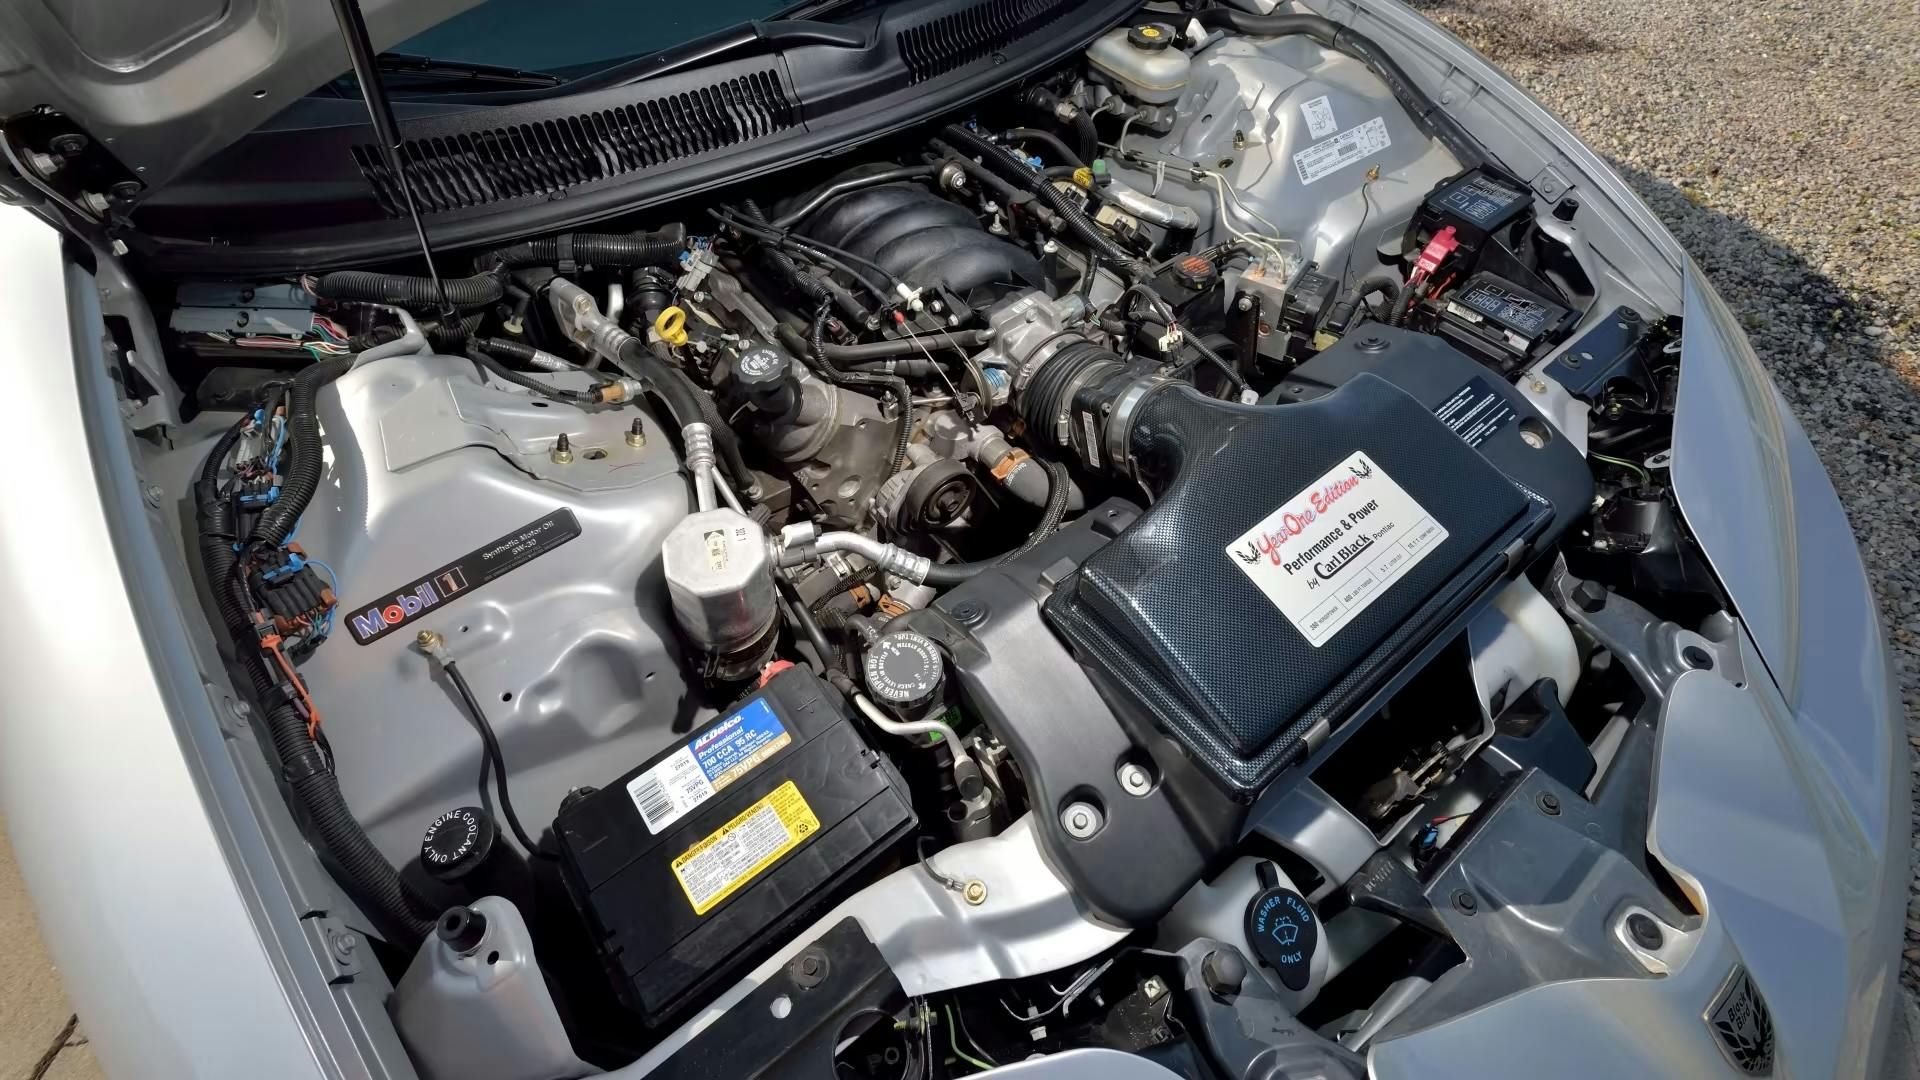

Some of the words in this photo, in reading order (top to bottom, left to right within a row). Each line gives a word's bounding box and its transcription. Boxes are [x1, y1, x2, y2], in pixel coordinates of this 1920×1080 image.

[1256, 509, 1317, 566] YearOne
[1310, 475, 1360, 514] Edition
[1283, 527, 1344, 575] Performance
[1339, 519, 1353, 532] &
[1348, 498, 1379, 525] Power
[482, 539, 520, 560] Synthetic
[520, 527, 542, 542] Motor
[542, 520, 555, 530] Oil
[1306, 576, 1320, 590] by
[1314, 555, 1341, 580] Carl
[1340, 533, 1371, 564] Black
[1372, 520, 1395, 541] Pontiac
[352, 582, 439, 639] Mobil
[870, 670, 884, 689] OPEN
[884, 676, 896, 688] LEVEL
[884, 686, 910, 698] NEVER
[695, 715, 742, 750] ACDelco
[698, 726, 744, 760] Professional
[702, 755, 716, 769] 700
[716, 745, 734, 759] CCA
[735, 738, 745, 748] 95
[745, 729, 757, 740] RC
[731, 754, 760, 778] 75VPG
[425, 810, 461, 842] ENGINE
[452, 812, 477, 860] COOLANT
[424, 846, 447, 863] ONLY
[1258, 896, 1280, 932] WASHER
[1287, 897, 1309, 922] FLUID
[1281, 951, 1303, 964] ONLY
[1728, 992, 1747, 1022] Black
[1736, 1004, 1750, 1031] Bird
